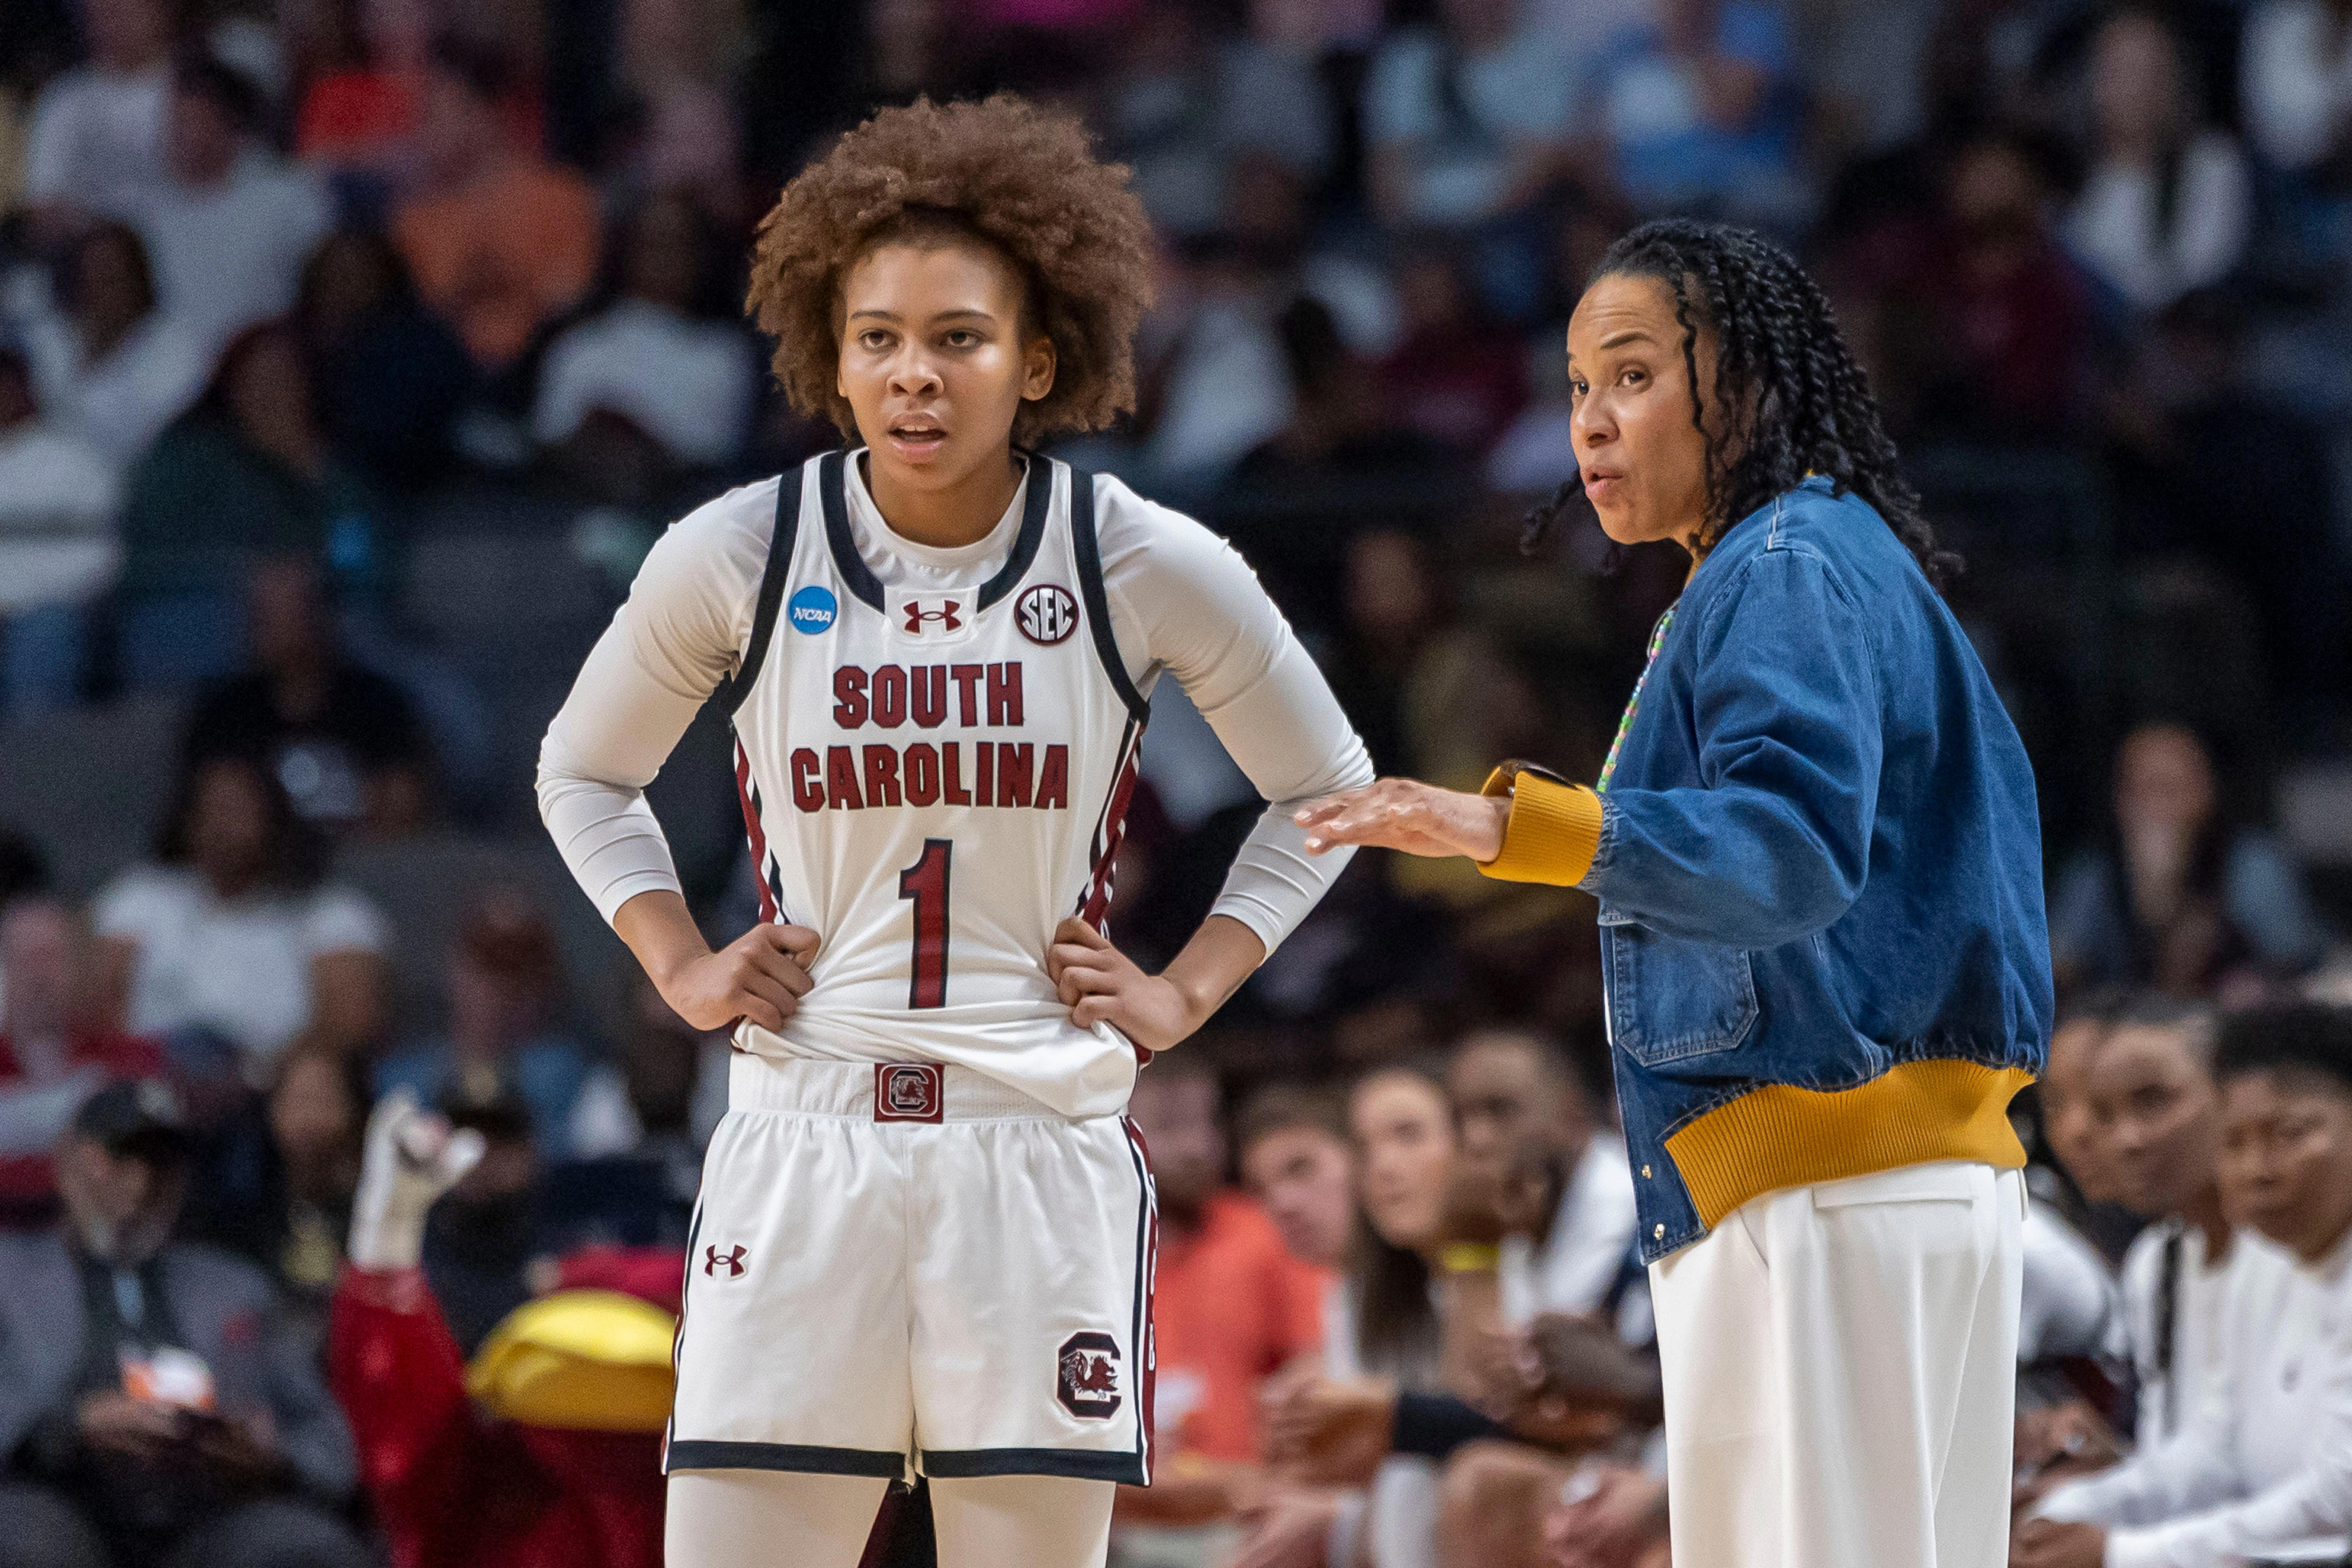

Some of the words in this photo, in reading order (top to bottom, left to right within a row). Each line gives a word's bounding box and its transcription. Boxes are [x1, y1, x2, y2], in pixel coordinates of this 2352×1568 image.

[794, 607, 832, 623] NCAA
[1019, 588, 1074, 641] SEC
[833, 661, 1026, 730] SOUTH
[790, 740, 1069, 814] CAROLINA
[898, 837, 953, 1010] 1
